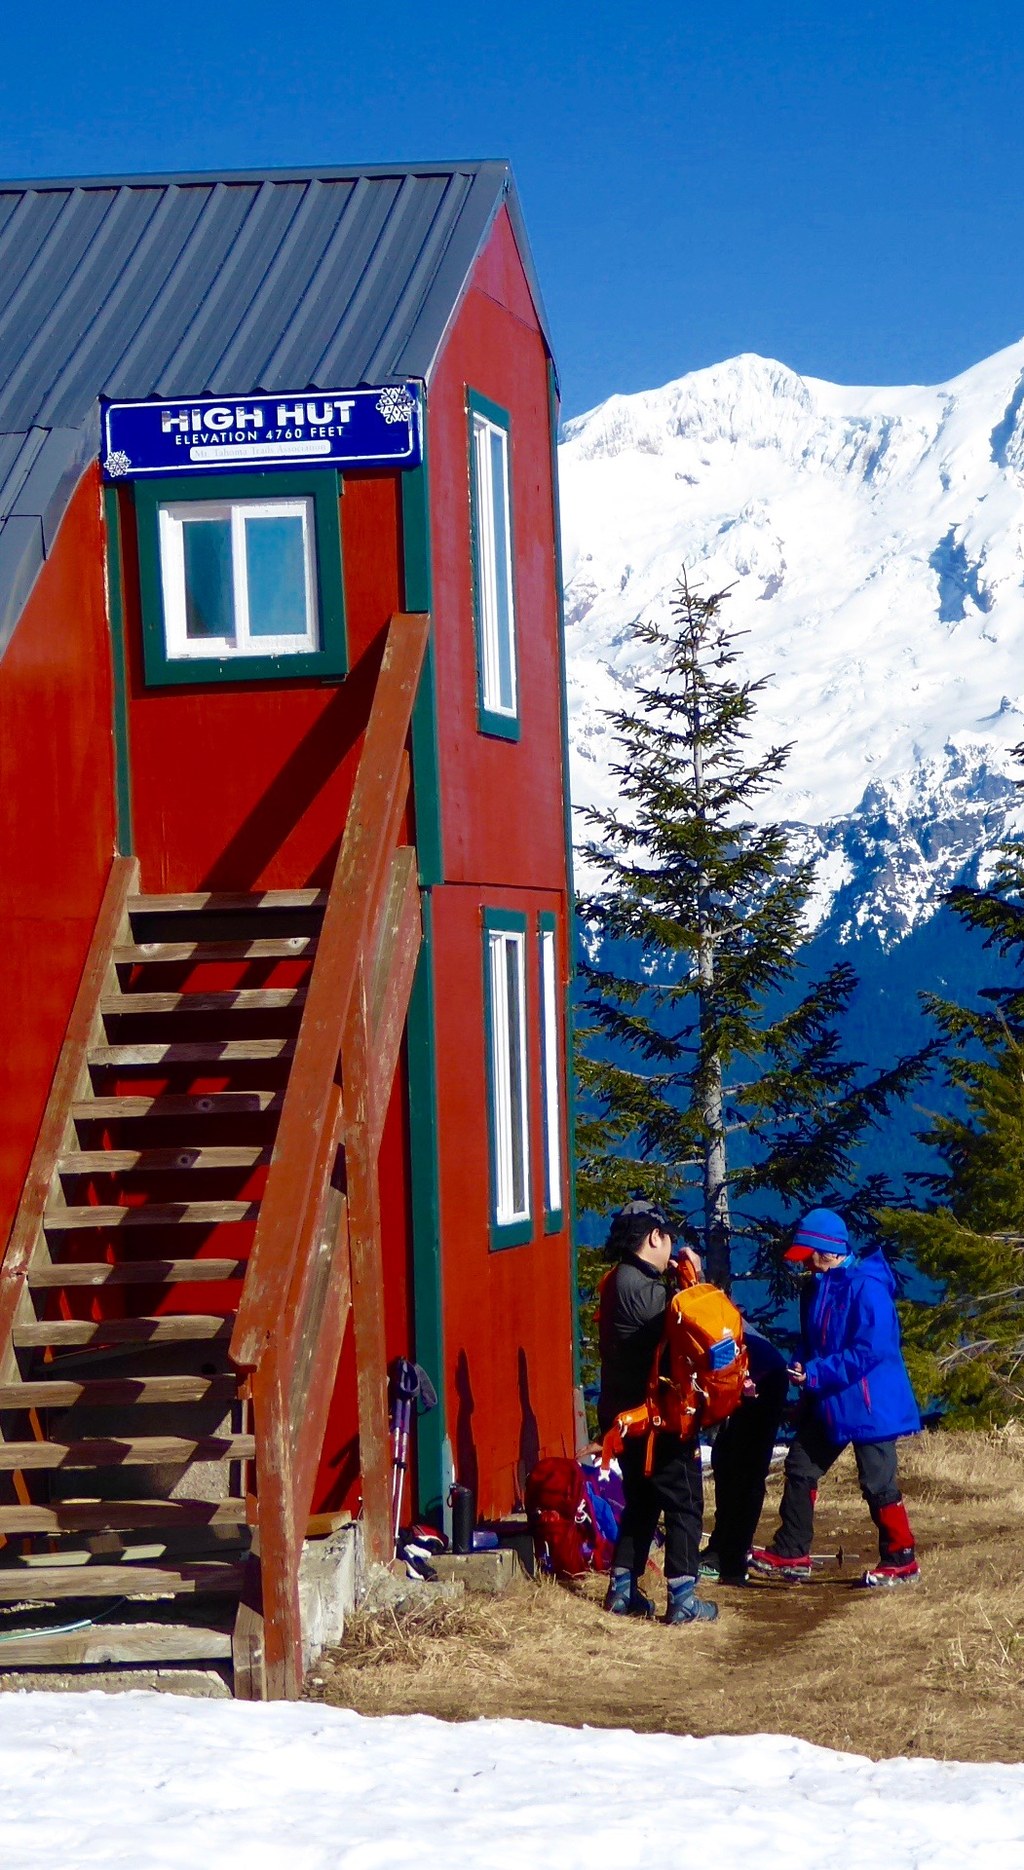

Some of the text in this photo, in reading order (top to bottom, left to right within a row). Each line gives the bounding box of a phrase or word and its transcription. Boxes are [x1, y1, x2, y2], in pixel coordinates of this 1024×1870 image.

[161, 400, 356, 433] HIGH HUT
[175, 426, 345, 445] ELEVATION 4760 FEET
[214, 446, 248, 457] Tahoma
[251, 445, 275, 455] Trails
[276, 442, 327, 454] Association
